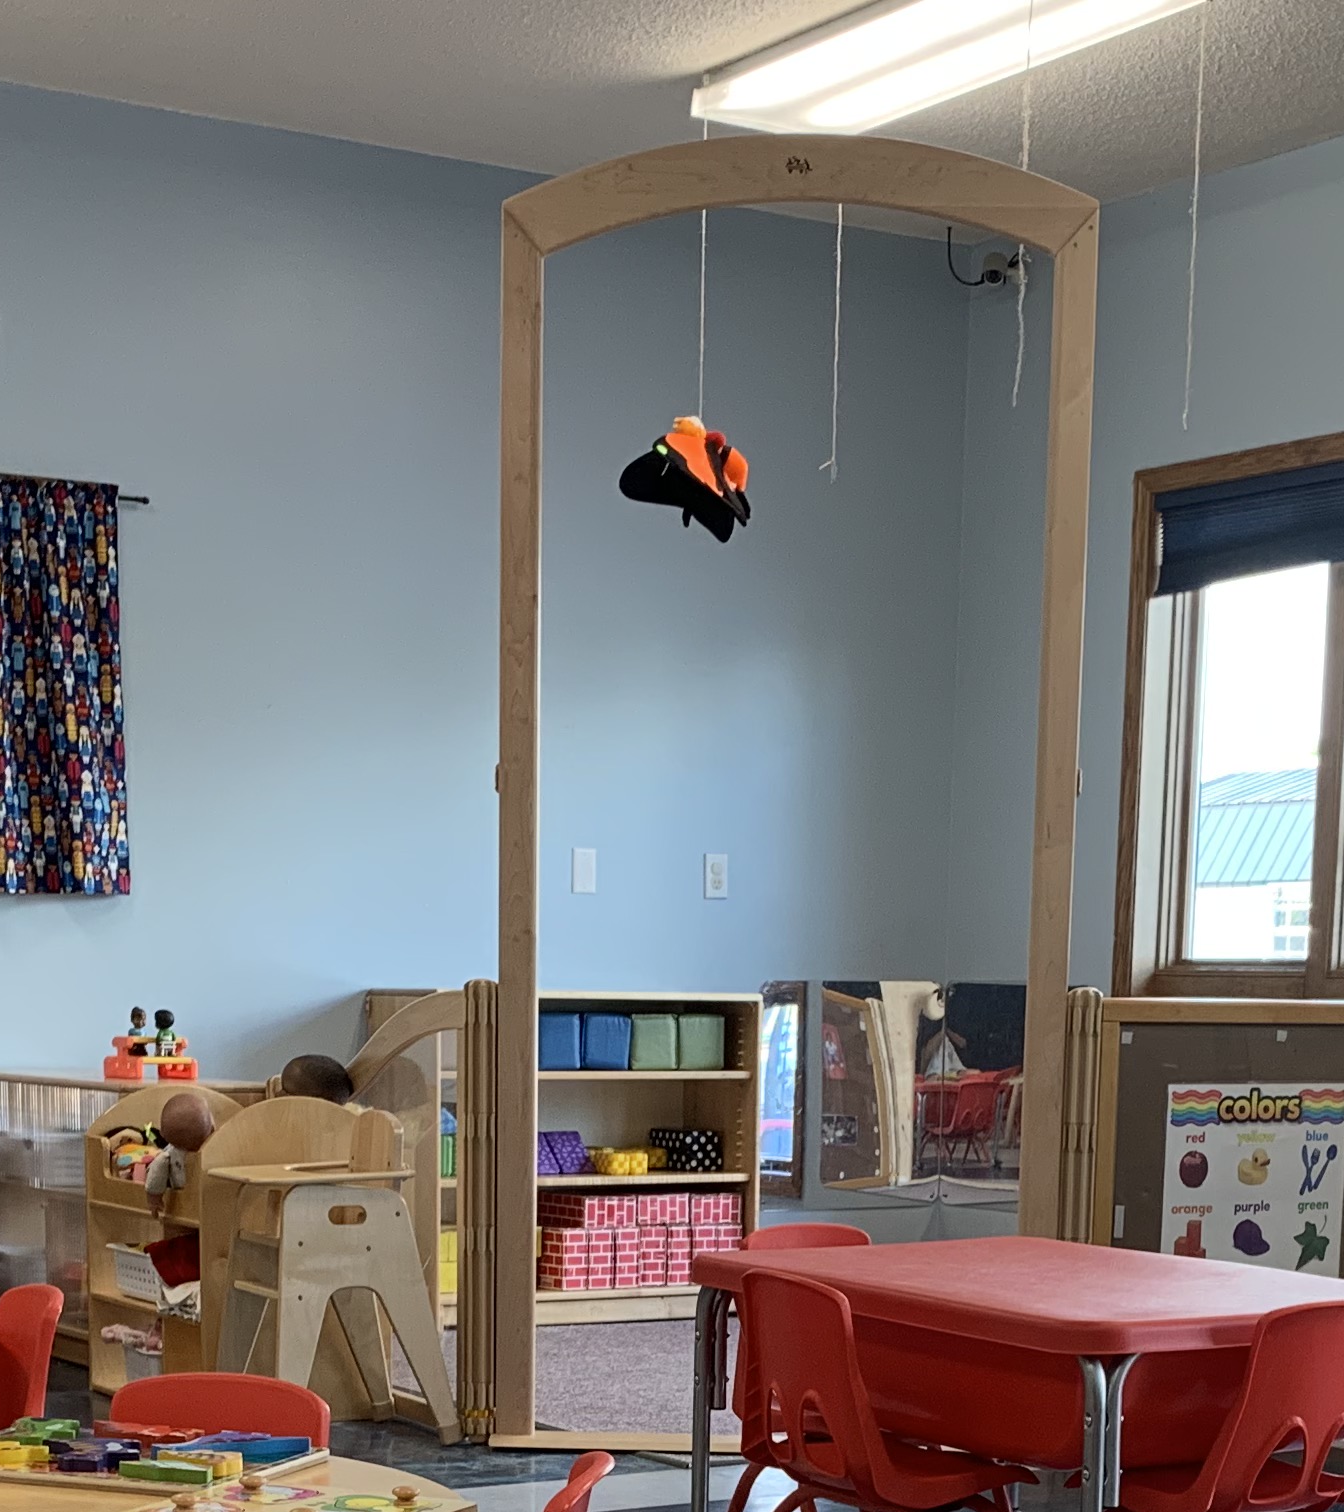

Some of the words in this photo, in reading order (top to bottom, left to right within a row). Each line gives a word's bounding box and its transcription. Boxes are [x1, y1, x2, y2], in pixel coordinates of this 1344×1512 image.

[1217, 1087, 1303, 1124] colors
[1185, 1131, 1206, 1144] red
[1236, 1129, 1276, 1147] yellow
[1305, 1130, 1329, 1142] blue
[1171, 1203, 1213, 1217] orange
[1234, 1200, 1271, 1216] purple
[1298, 1200, 1329, 1214] green
